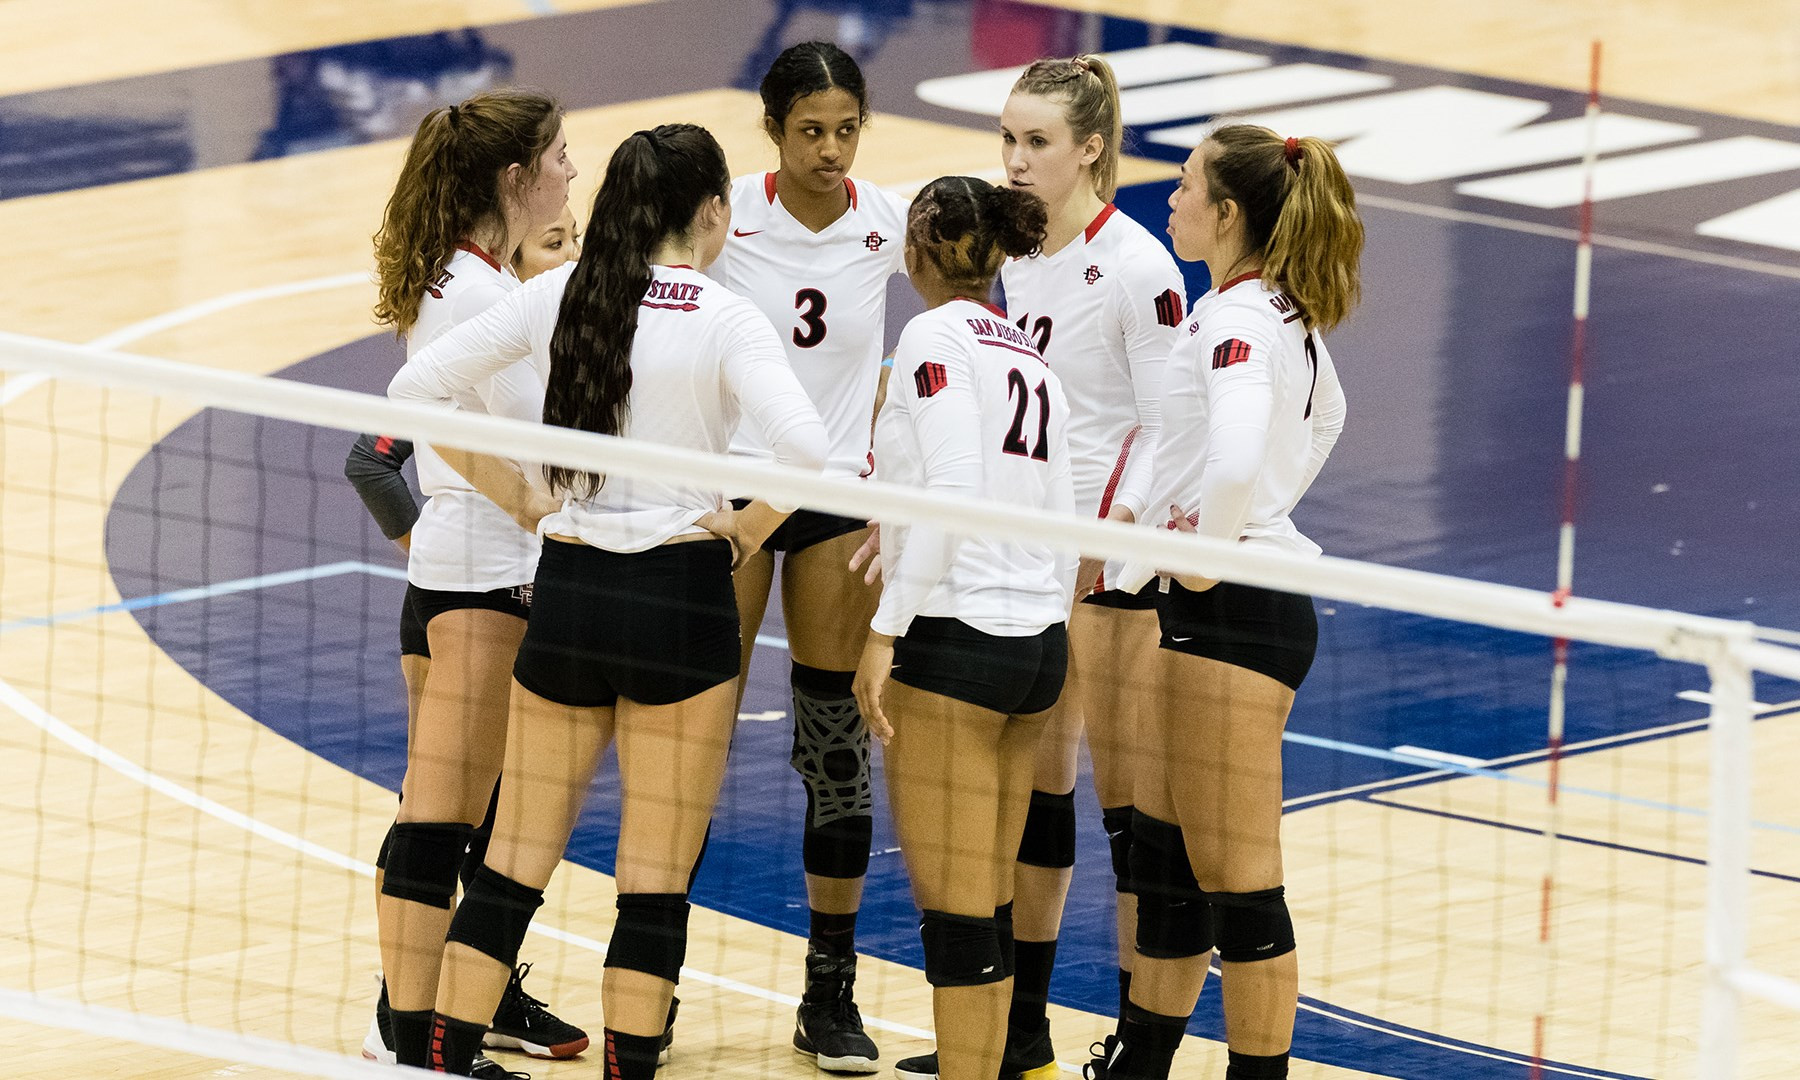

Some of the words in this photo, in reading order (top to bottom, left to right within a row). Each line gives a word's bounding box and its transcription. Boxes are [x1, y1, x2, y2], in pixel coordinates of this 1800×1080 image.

[647, 279, 704, 301] STATE
[793, 288, 827, 348] 3
[966, 318, 995, 337] SAN
[992, 320, 1023, 346] DIEGO
[1002, 367, 1050, 462] 21
